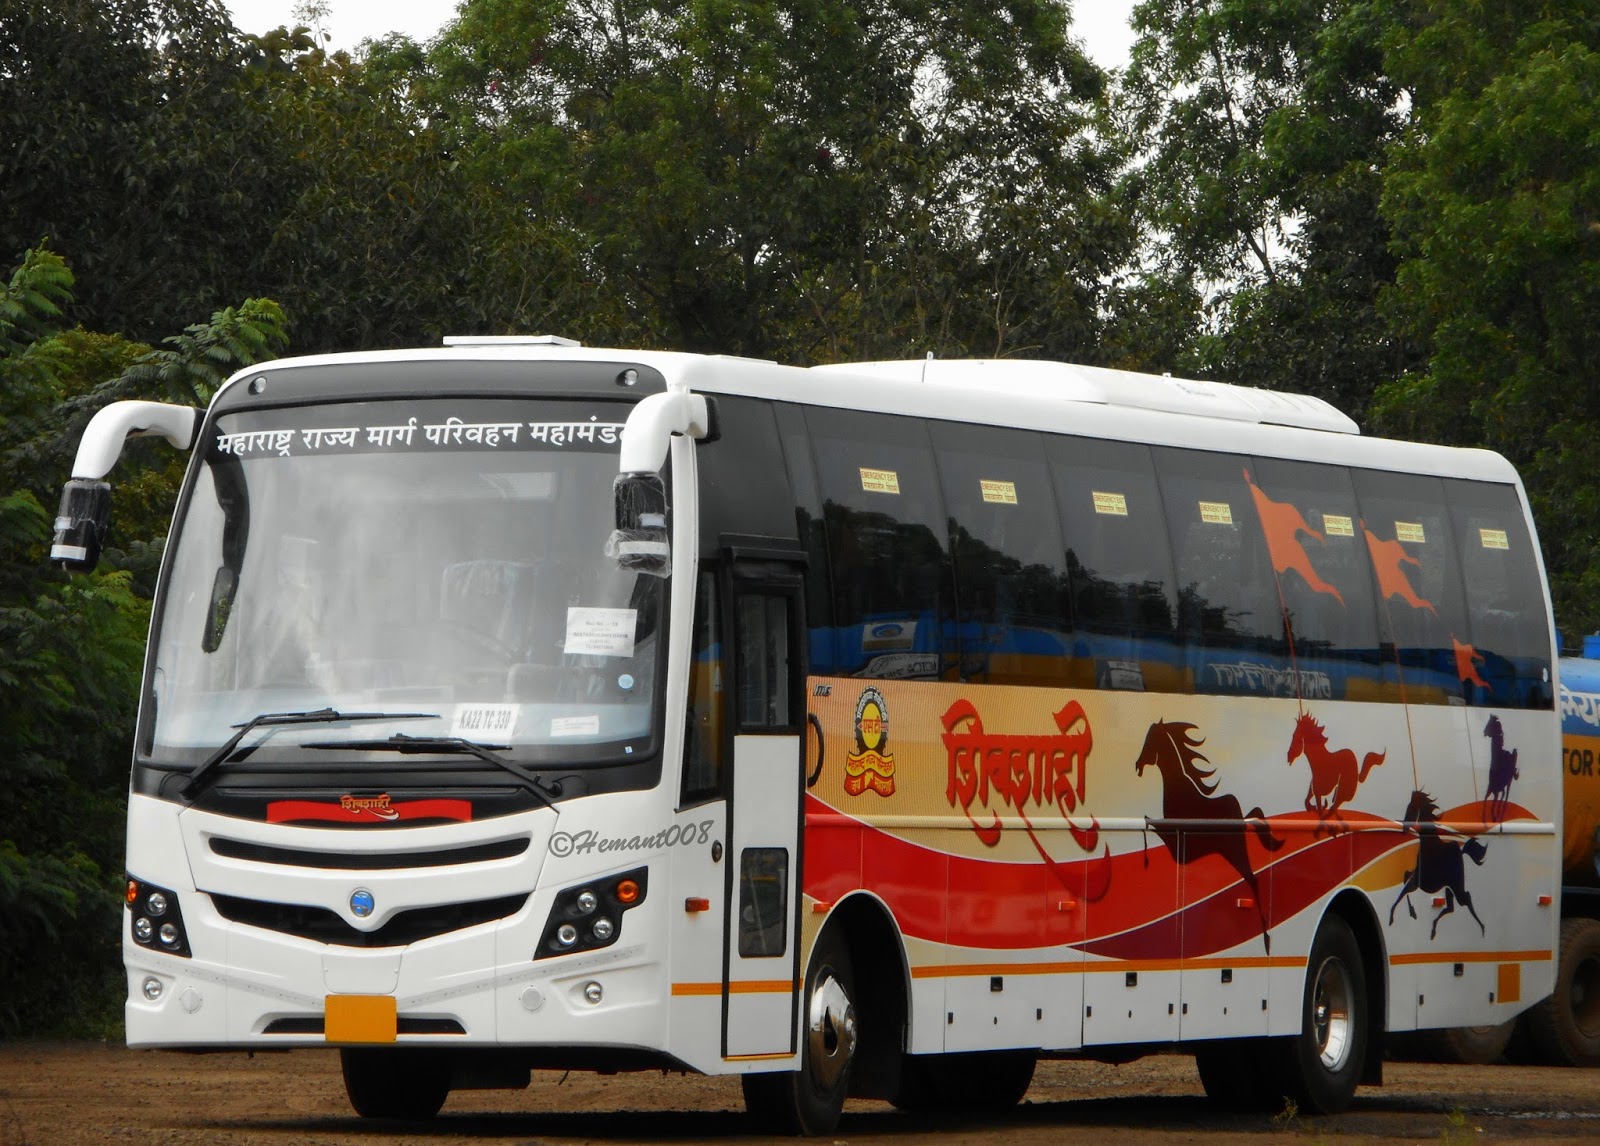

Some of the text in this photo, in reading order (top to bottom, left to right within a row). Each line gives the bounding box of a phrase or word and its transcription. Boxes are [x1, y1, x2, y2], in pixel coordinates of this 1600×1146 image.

[217, 429, 295, 456] महाराष्ट्र
[302, 427, 360, 450] राज्य
[366, 417, 418, 447] मार्ग
[424, 417, 523, 448] परिवहन
[459, 710, 512, 730] KA22 TC 330
[340, 794, 400, 820] शिवशाही
[940, 699, 1111, 902] शिवशाही
